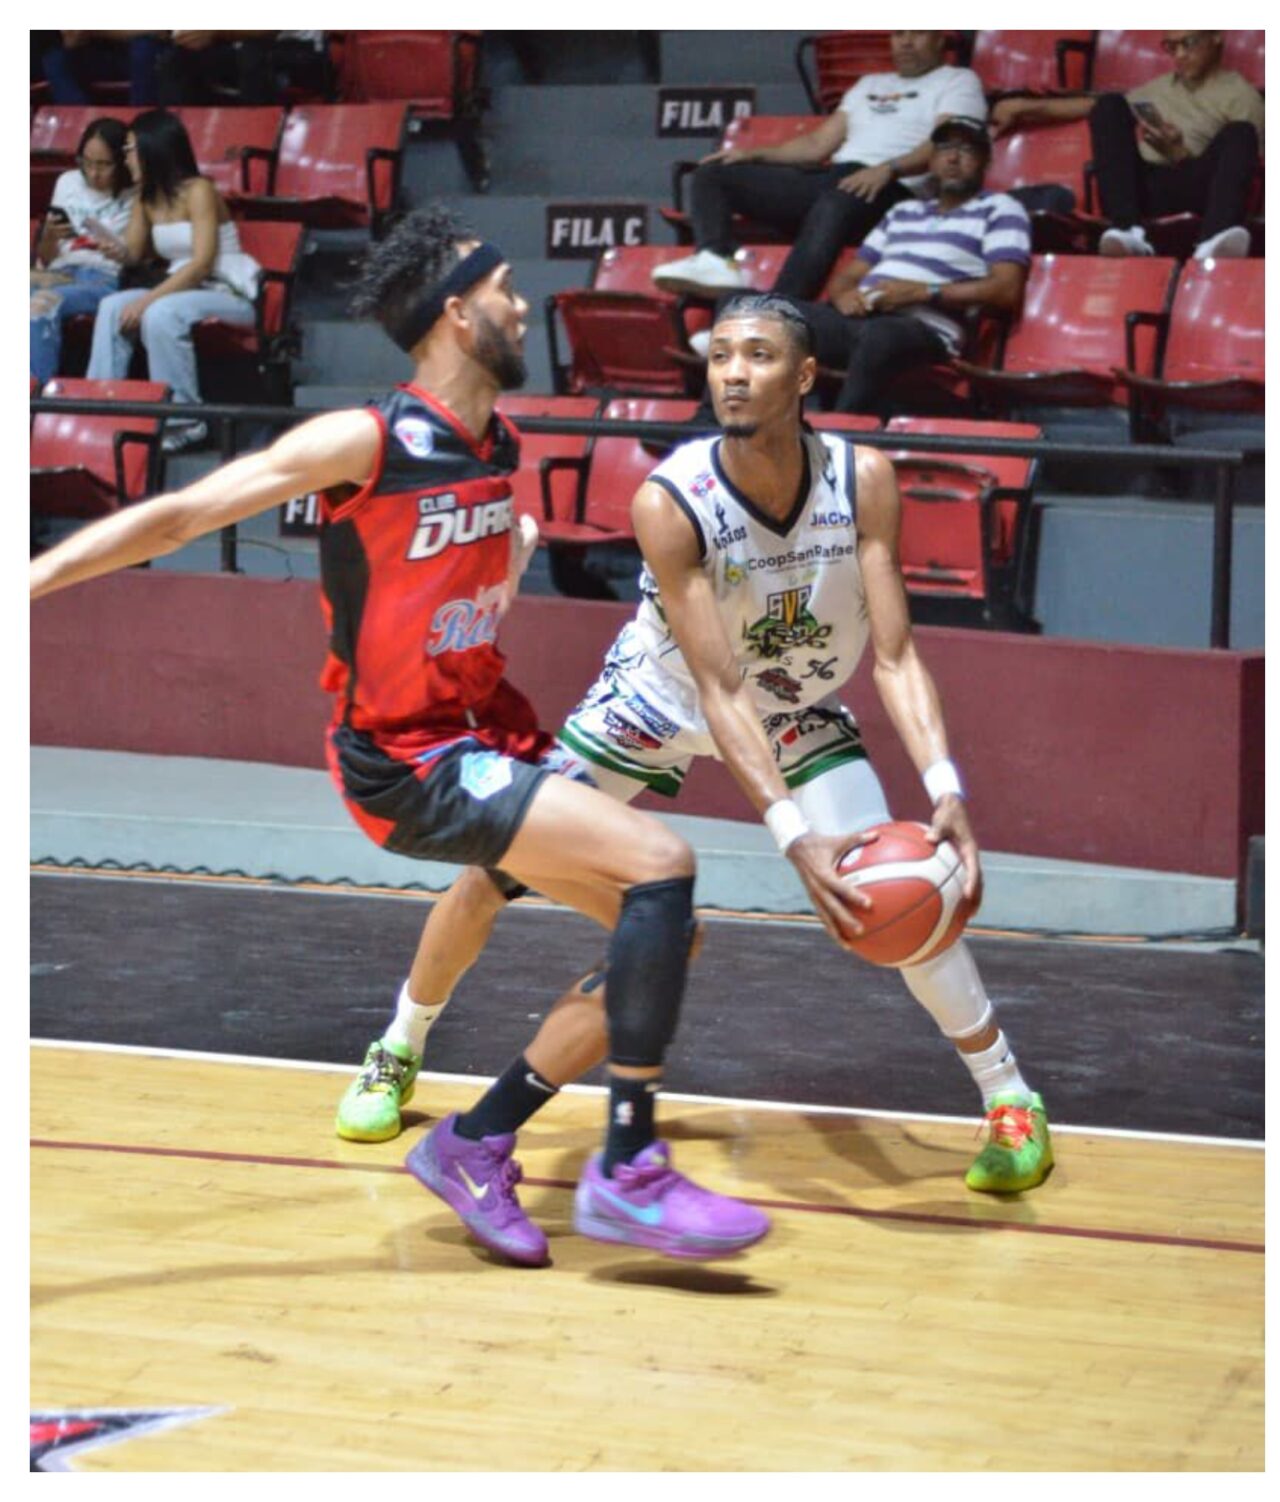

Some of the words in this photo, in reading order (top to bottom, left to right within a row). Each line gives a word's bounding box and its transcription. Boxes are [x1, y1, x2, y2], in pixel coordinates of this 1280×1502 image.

[661, 101, 722, 128] FILA
[552, 218, 615, 246] FILA
[624, 218, 642, 246] C
[285, 495, 321, 524] FI
[748, 544, 854, 571] CoopSanRafae
[801, 656, 838, 680] 56
